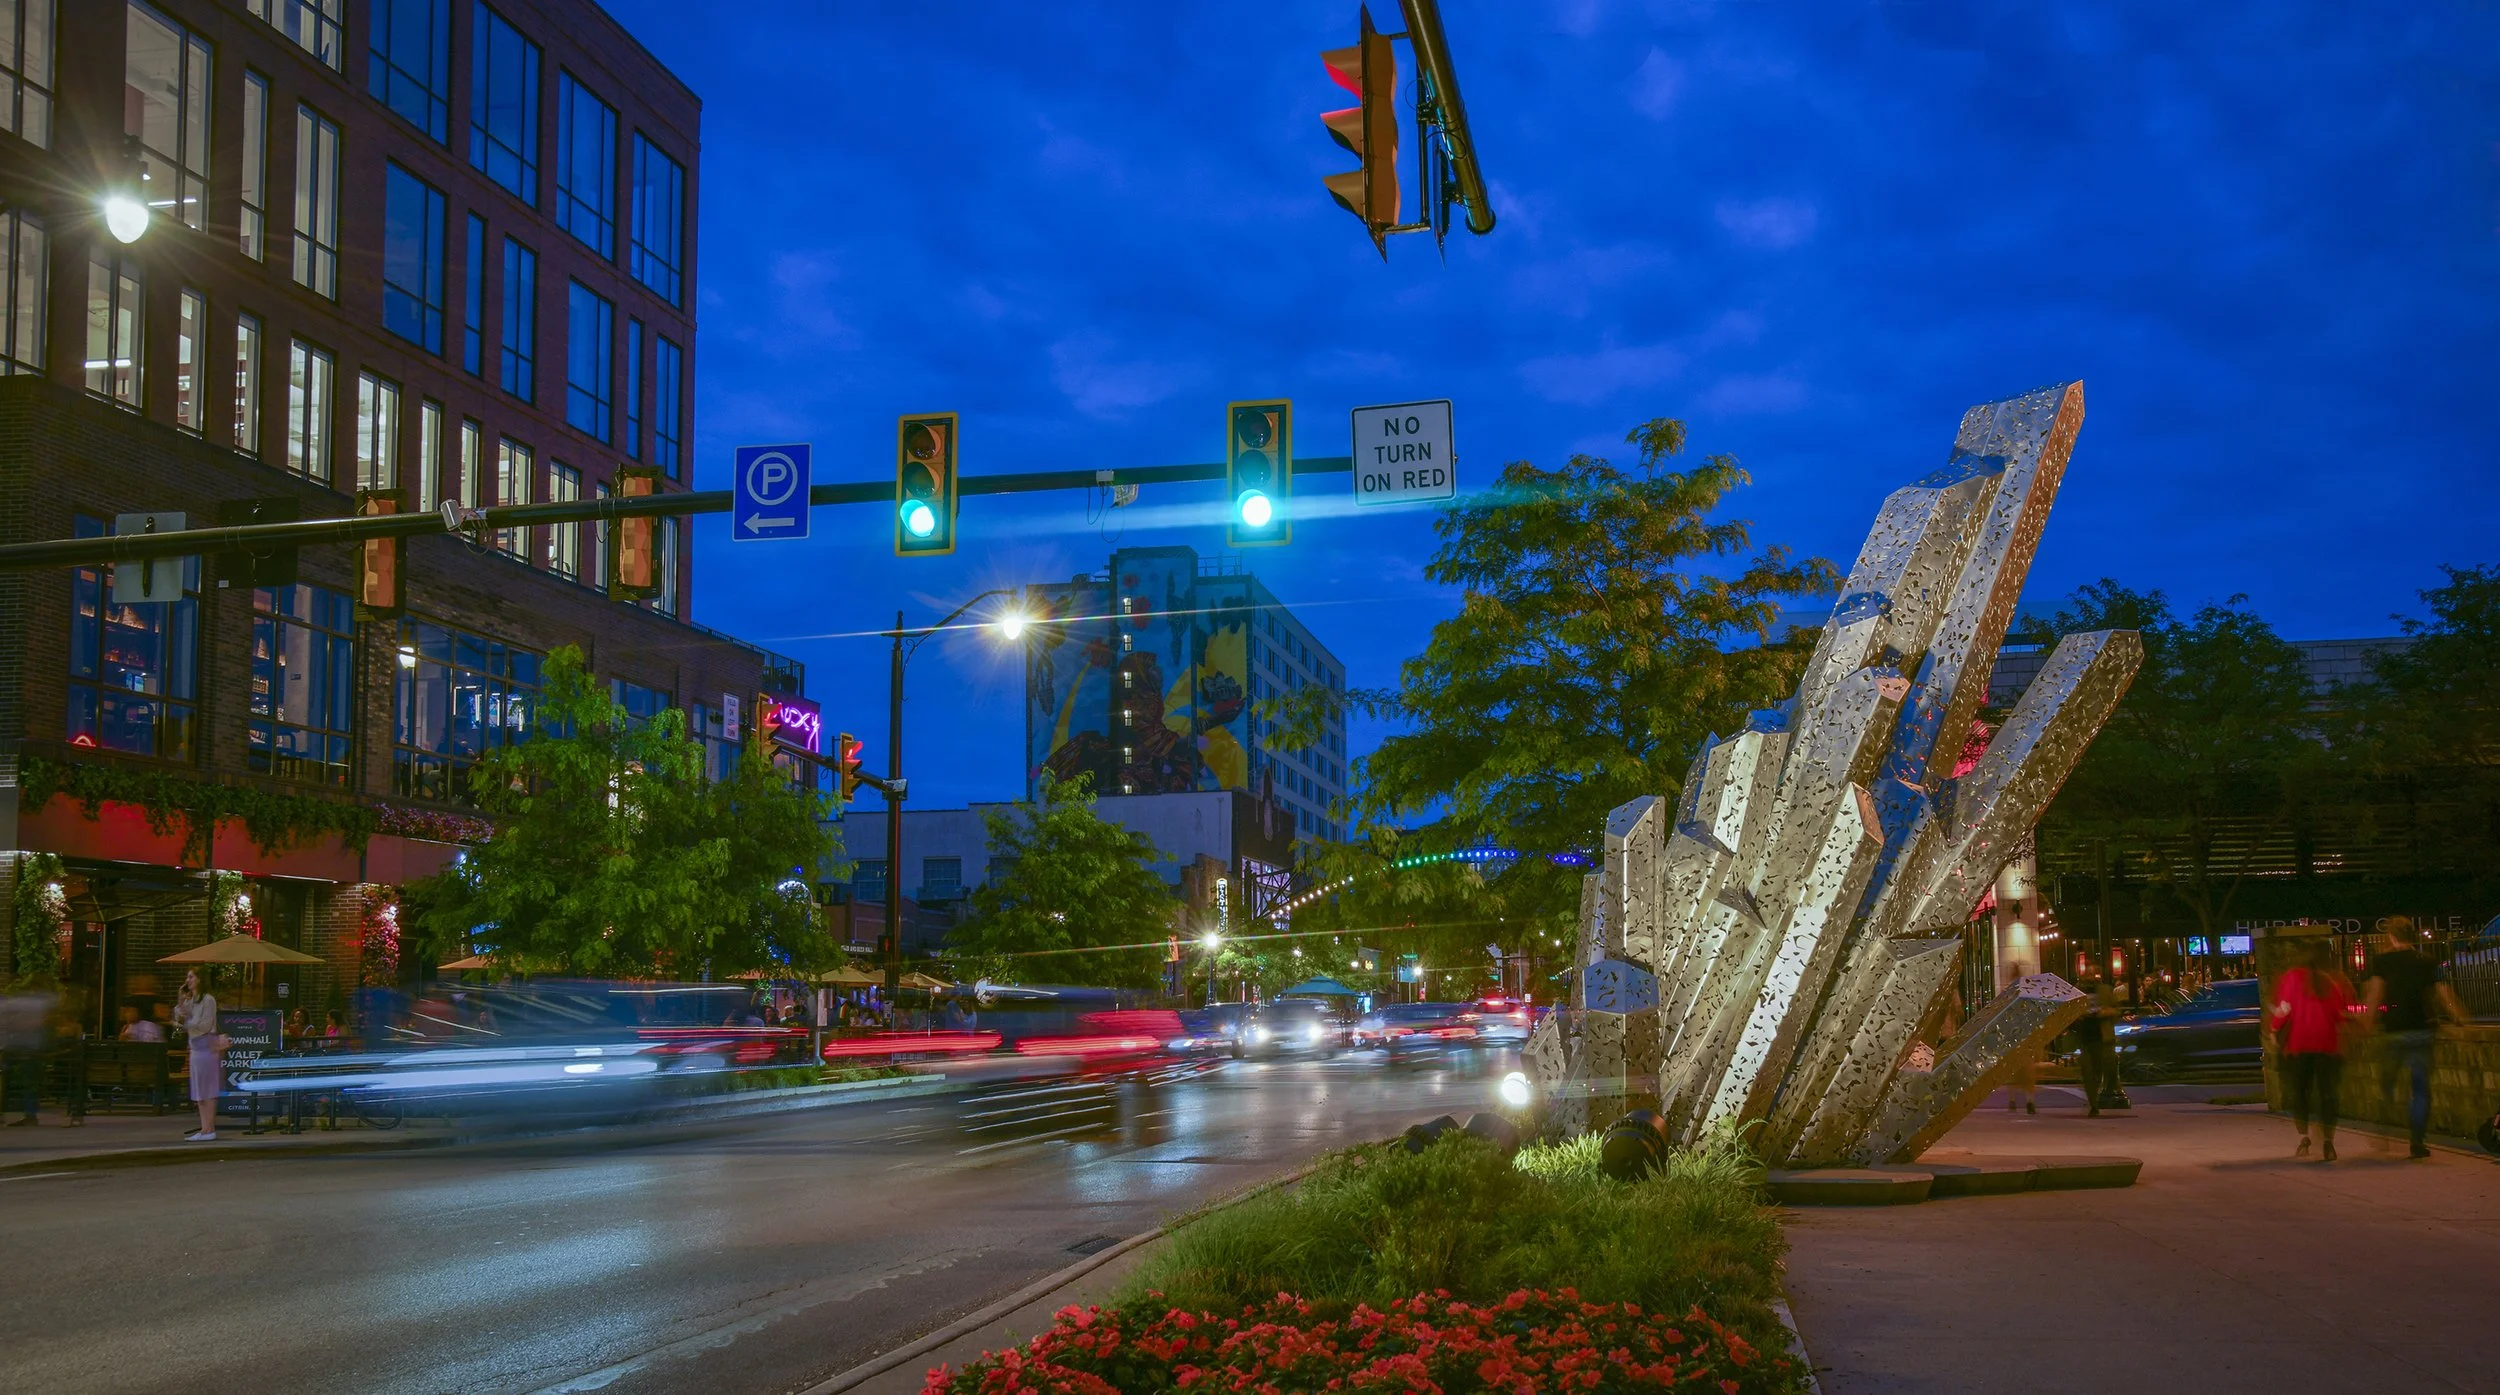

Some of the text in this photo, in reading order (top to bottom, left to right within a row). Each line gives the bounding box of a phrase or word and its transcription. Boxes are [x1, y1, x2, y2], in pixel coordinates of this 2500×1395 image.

[1384, 416, 1420, 436] NO
[1374, 442, 1432, 464] TURN
[762, 463, 787, 495] P
[1363, 468, 1446, 493] ON RED
[2375, 915, 2462, 933] GILLE
[228, 1035, 271, 1045] OWNHALL
[221, 1060, 269, 1068] PARKIG
[228, 1051, 262, 1059] VALET
